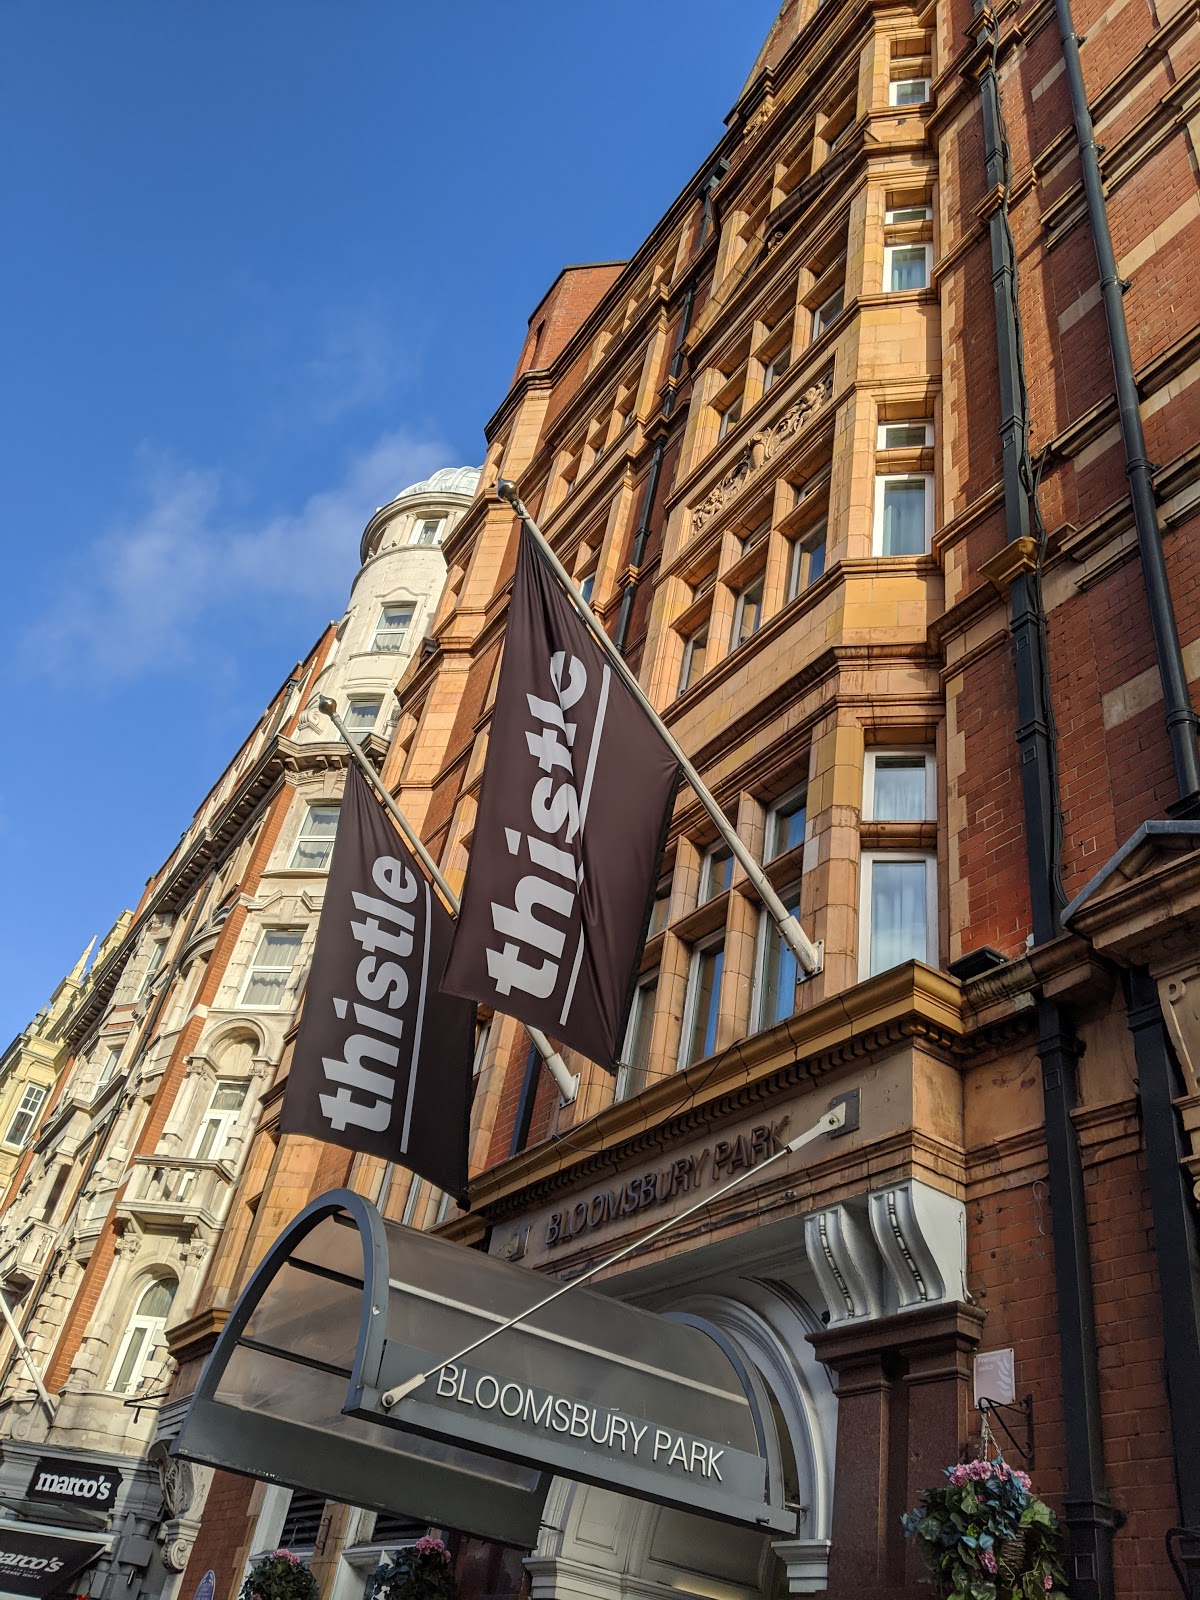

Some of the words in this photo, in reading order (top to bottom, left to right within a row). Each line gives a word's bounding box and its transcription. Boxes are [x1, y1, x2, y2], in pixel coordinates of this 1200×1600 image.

[485, 650, 588, 999] thistle
[319, 855, 418, 1133] thistle
[544, 1148, 710, 1245] BLOOMSBURY
[712, 1115, 790, 1181] PARK
[34, 1472, 112, 1499] marco's
[436, 1364, 648, 1455] BLOOMSBURY
[652, 1429, 725, 1481] PARK
